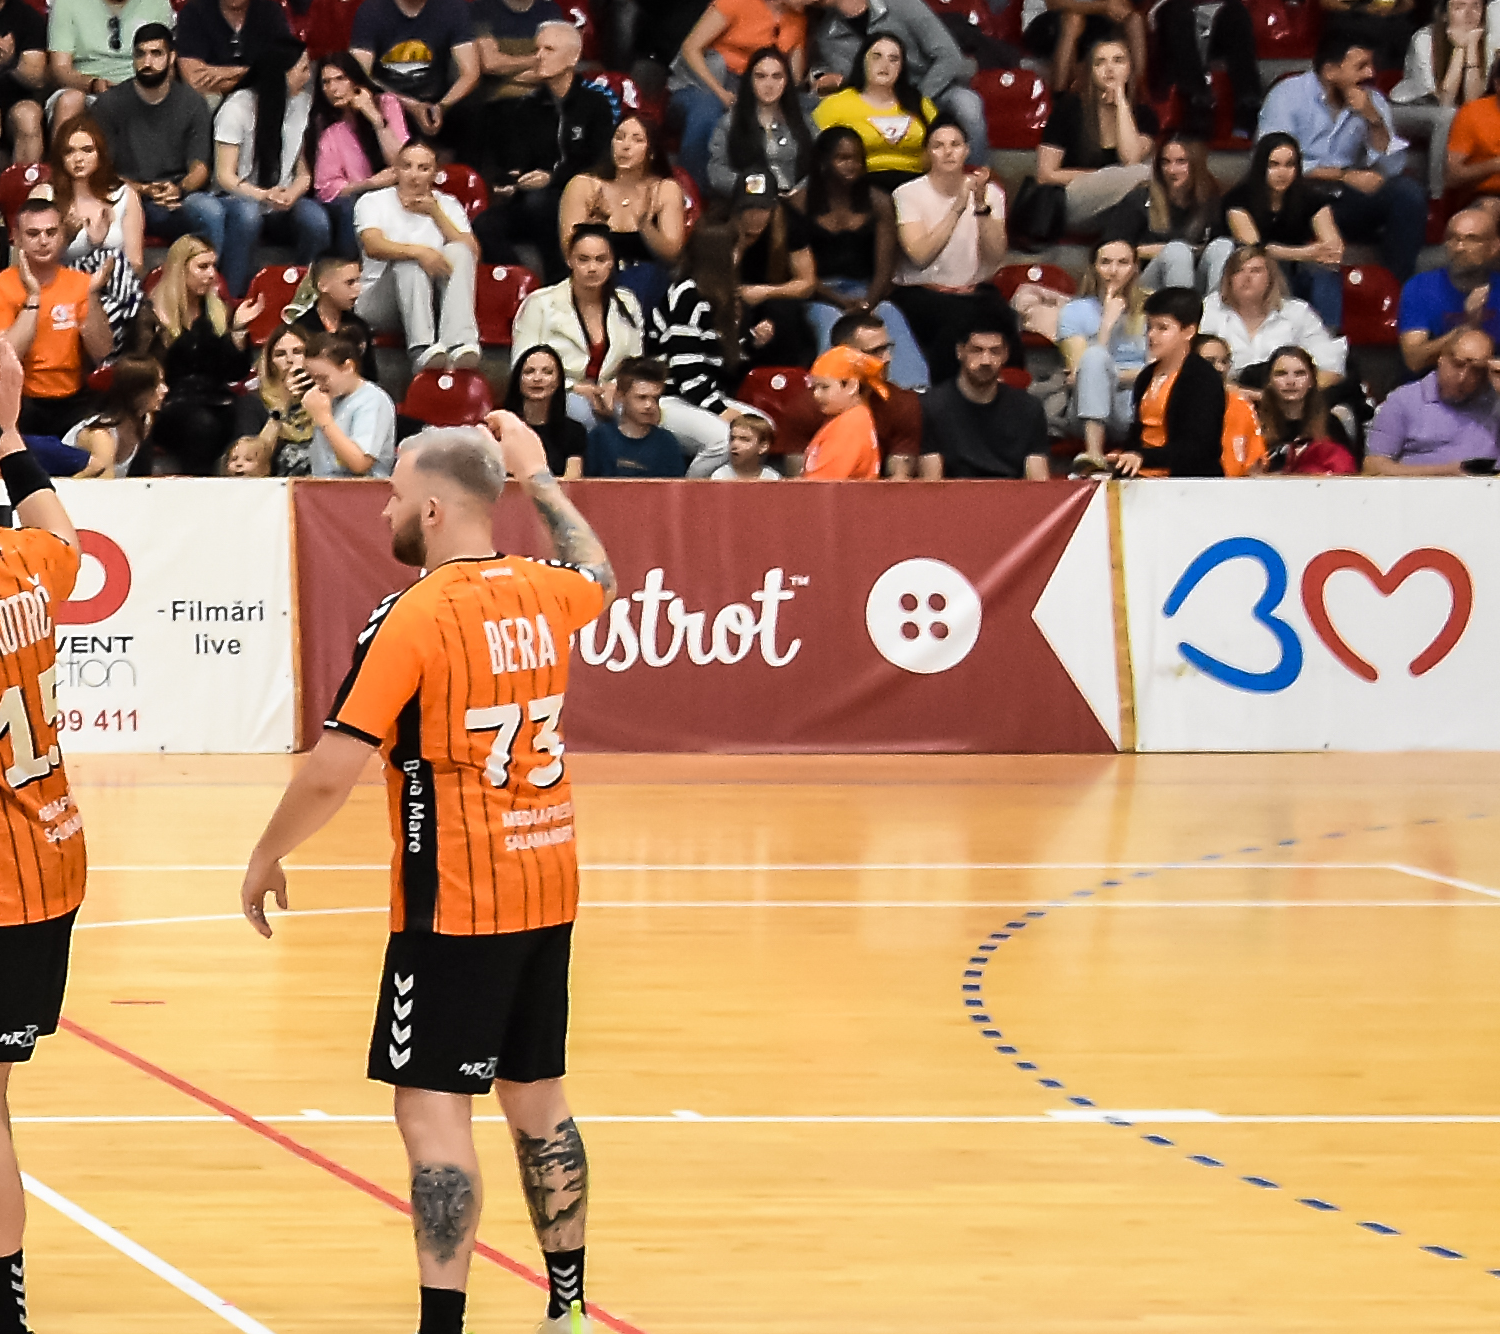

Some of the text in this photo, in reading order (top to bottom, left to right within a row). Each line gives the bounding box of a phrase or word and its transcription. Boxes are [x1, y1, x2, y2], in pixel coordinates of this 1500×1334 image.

[194, 633, 242, 656] live
[483, 613, 558, 675] BERA
[93, 708, 139, 733] 411
[465, 692, 566, 787] 73
[407, 801, 425, 854] Mare
